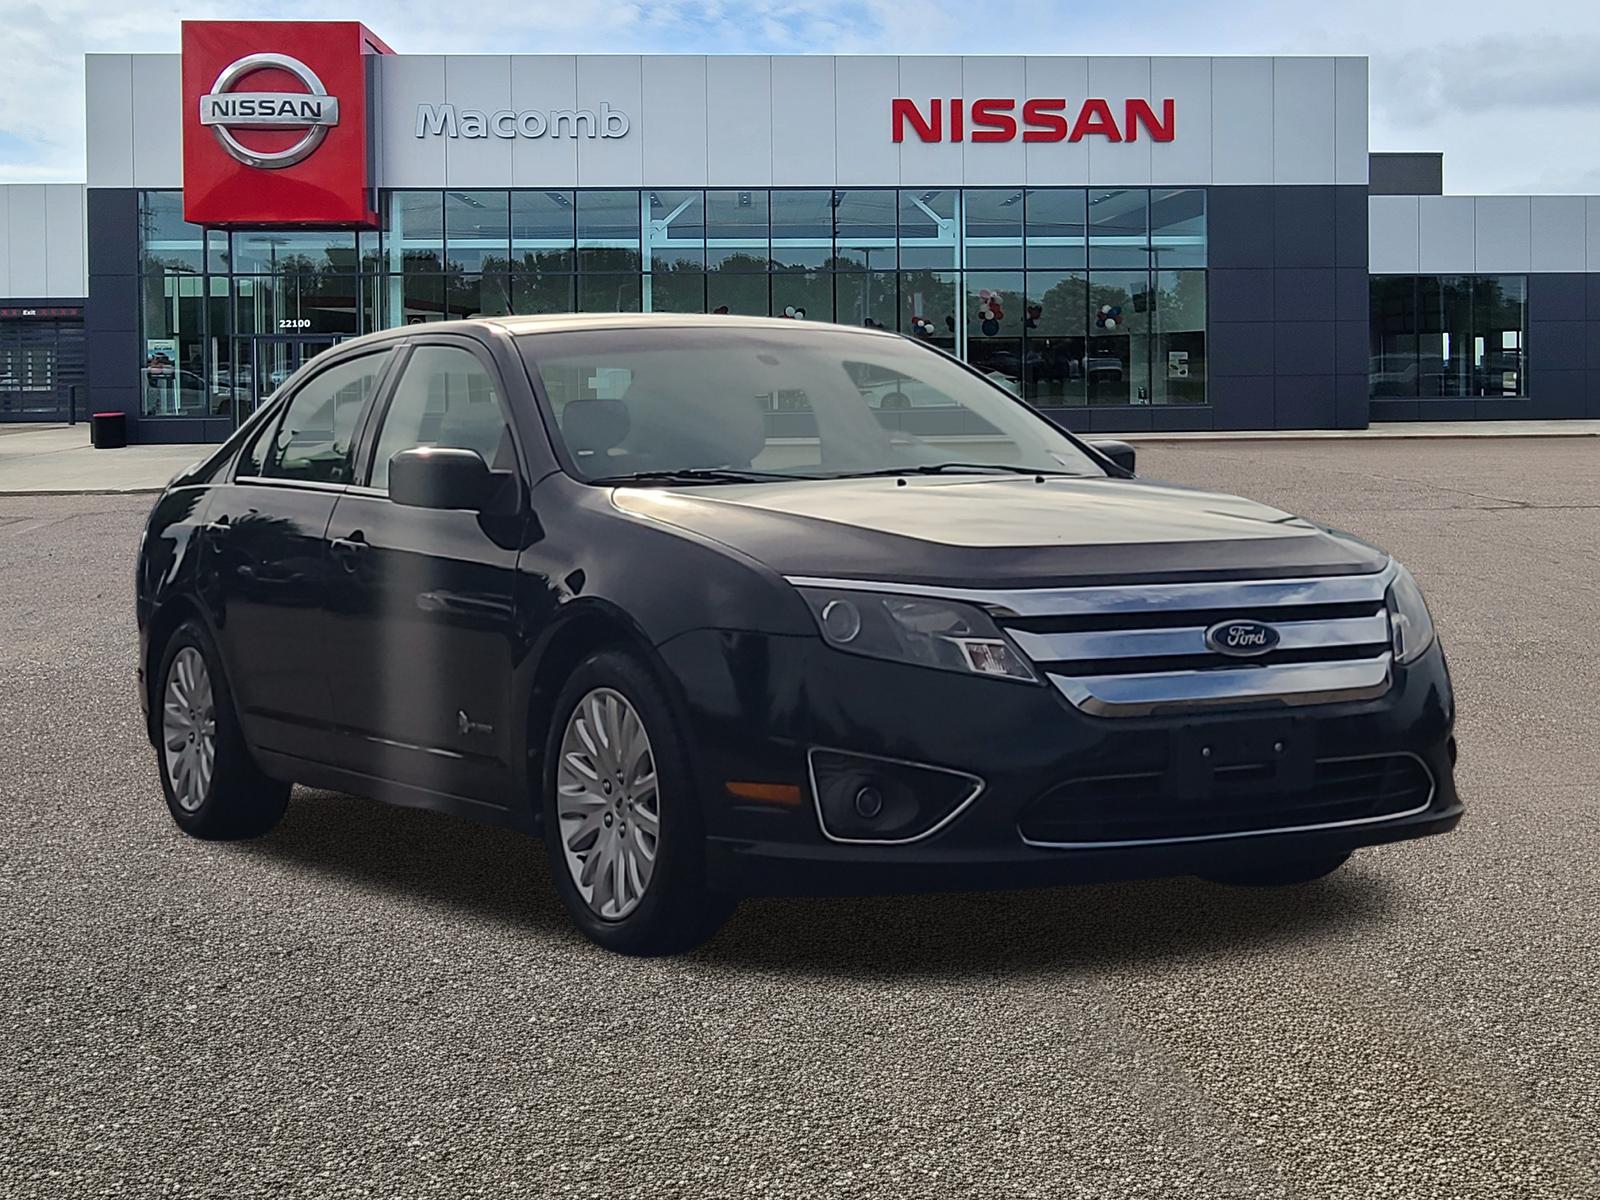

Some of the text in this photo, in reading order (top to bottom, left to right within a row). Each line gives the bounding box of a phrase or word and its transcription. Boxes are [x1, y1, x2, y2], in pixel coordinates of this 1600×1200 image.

[212, 100, 322, 118] NISSAN
[415, 102, 630, 140] Macomb
[892, 98, 1175, 143] NISSAN
[279, 319, 311, 328] 22100
[1227, 625, 1267, 646] Ford
